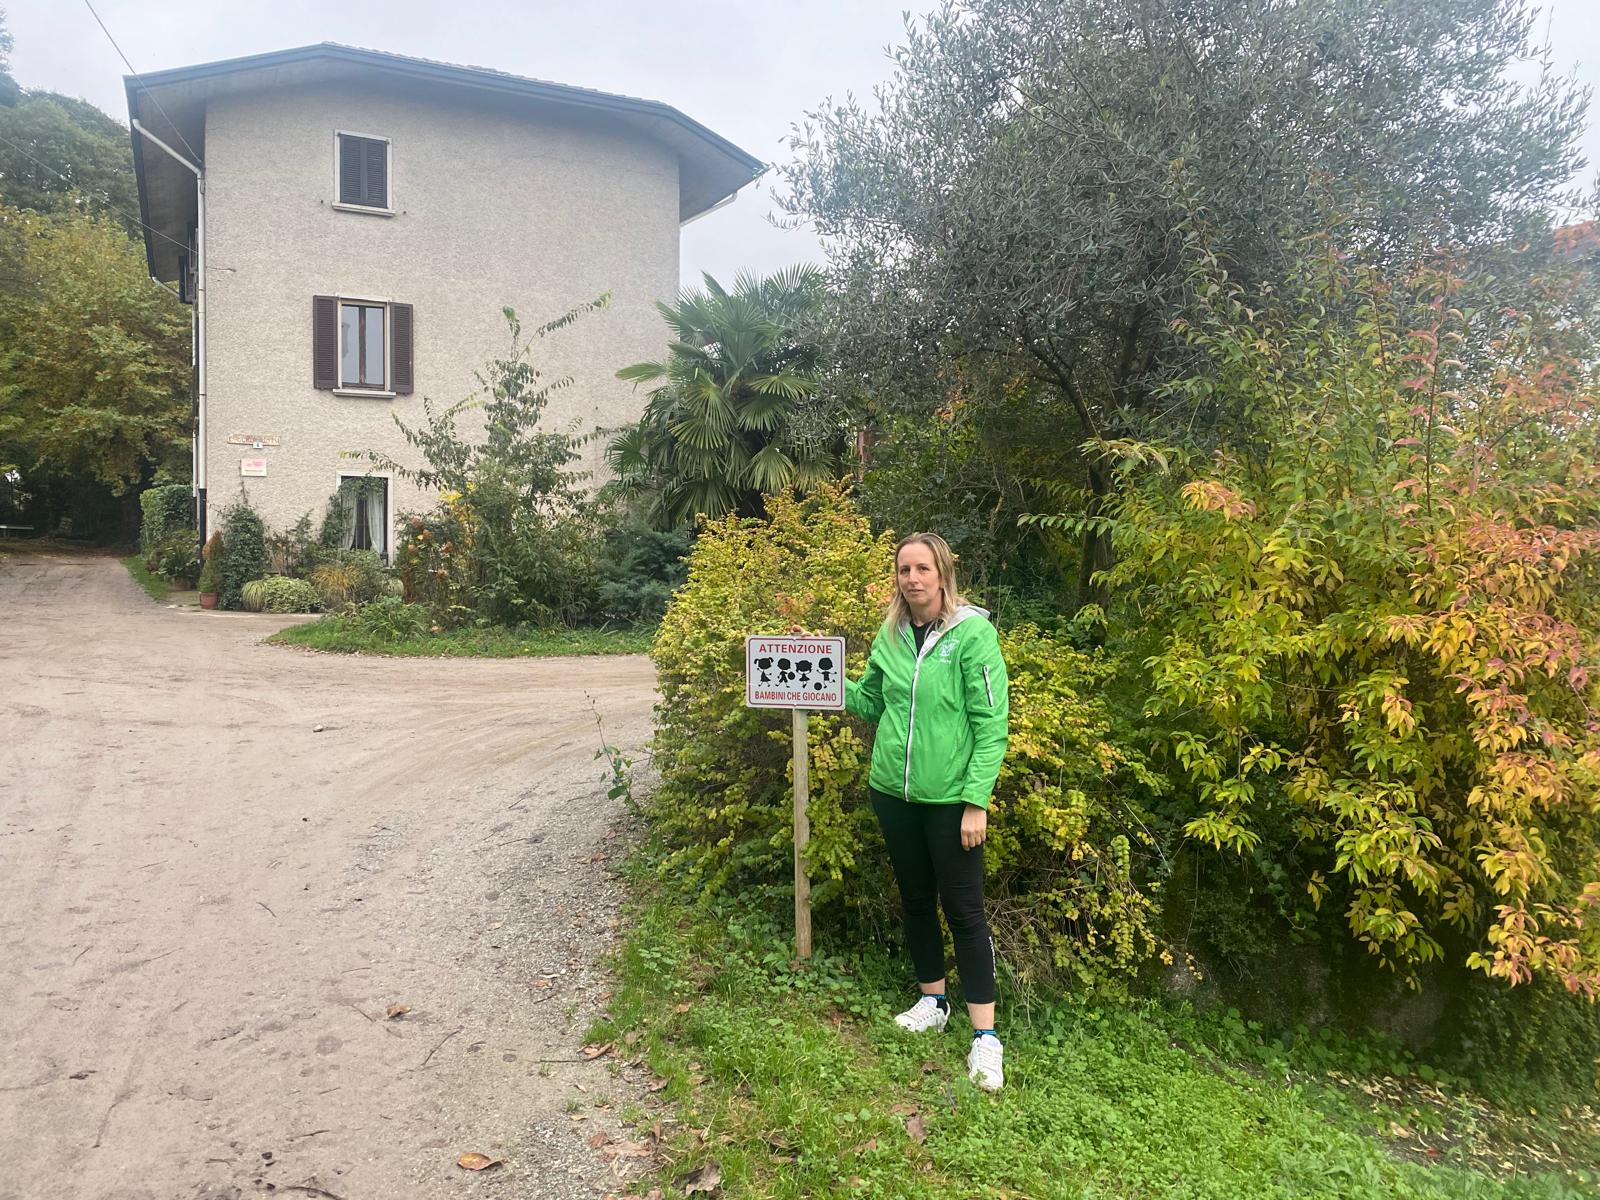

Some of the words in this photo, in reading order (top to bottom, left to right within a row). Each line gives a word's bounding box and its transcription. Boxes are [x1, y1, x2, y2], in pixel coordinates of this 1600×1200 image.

[759, 643, 832, 654] ATTENZIONE
[755, 691, 785, 700] BAMBINI
[787, 691, 801, 701] CHE
[802, 692, 837, 702] GIOCANO
